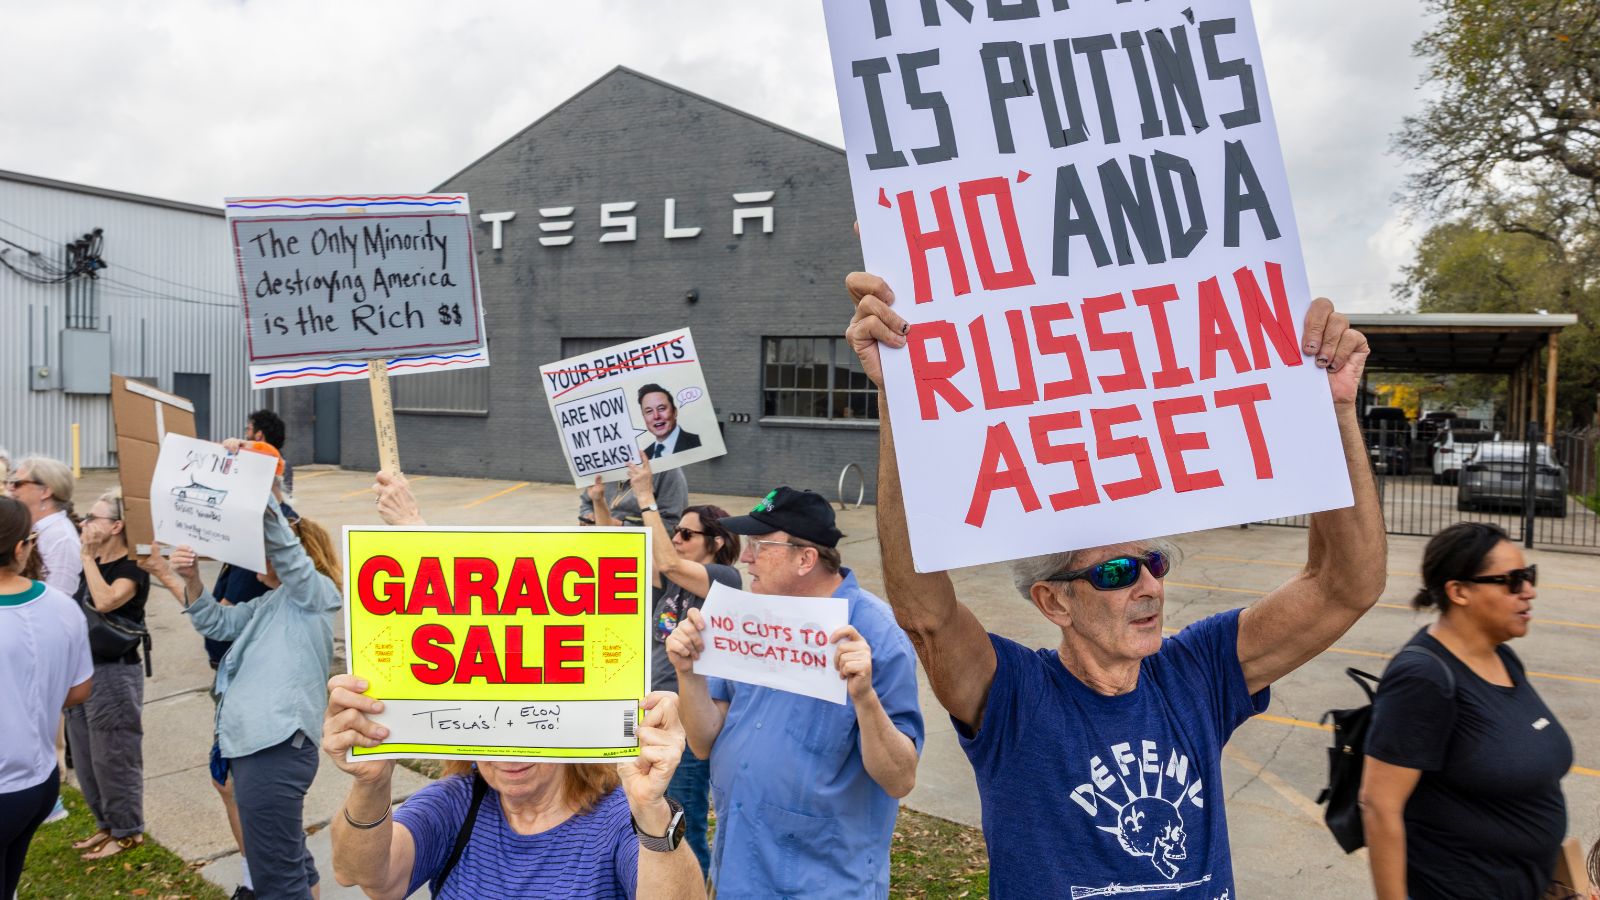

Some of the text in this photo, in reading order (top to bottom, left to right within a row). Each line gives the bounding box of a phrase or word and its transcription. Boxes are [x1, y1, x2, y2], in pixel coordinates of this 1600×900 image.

[852, 7, 1262, 171] IS PUTIN'S
[479, 191, 775, 249] TESLA
[1052, 149, 1208, 277] AND
[1223, 139, 1282, 248] A
[249, 219, 448, 270] The Only Minority
[255, 266, 457, 303] destroying America
[264, 301, 463, 336] is the Rich $$
[905, 260, 1304, 421] RUSSIAN
[547, 339, 686, 392] YOUR BENEFITS
[561, 395, 625, 428] ARE NOW
[572, 422, 622, 449] MY TAX
[964, 383, 1274, 528] ASSET
[573, 444, 634, 472] BREAKS!
[357, 555, 638, 616] GARAGE
[710, 615, 828, 647] NO CUTS TO
[713, 636, 827, 668] EDUCATION
[410, 623, 585, 685] SALE
[520, 705, 561, 717] ELON
[527, 718, 560, 730] TOO!
